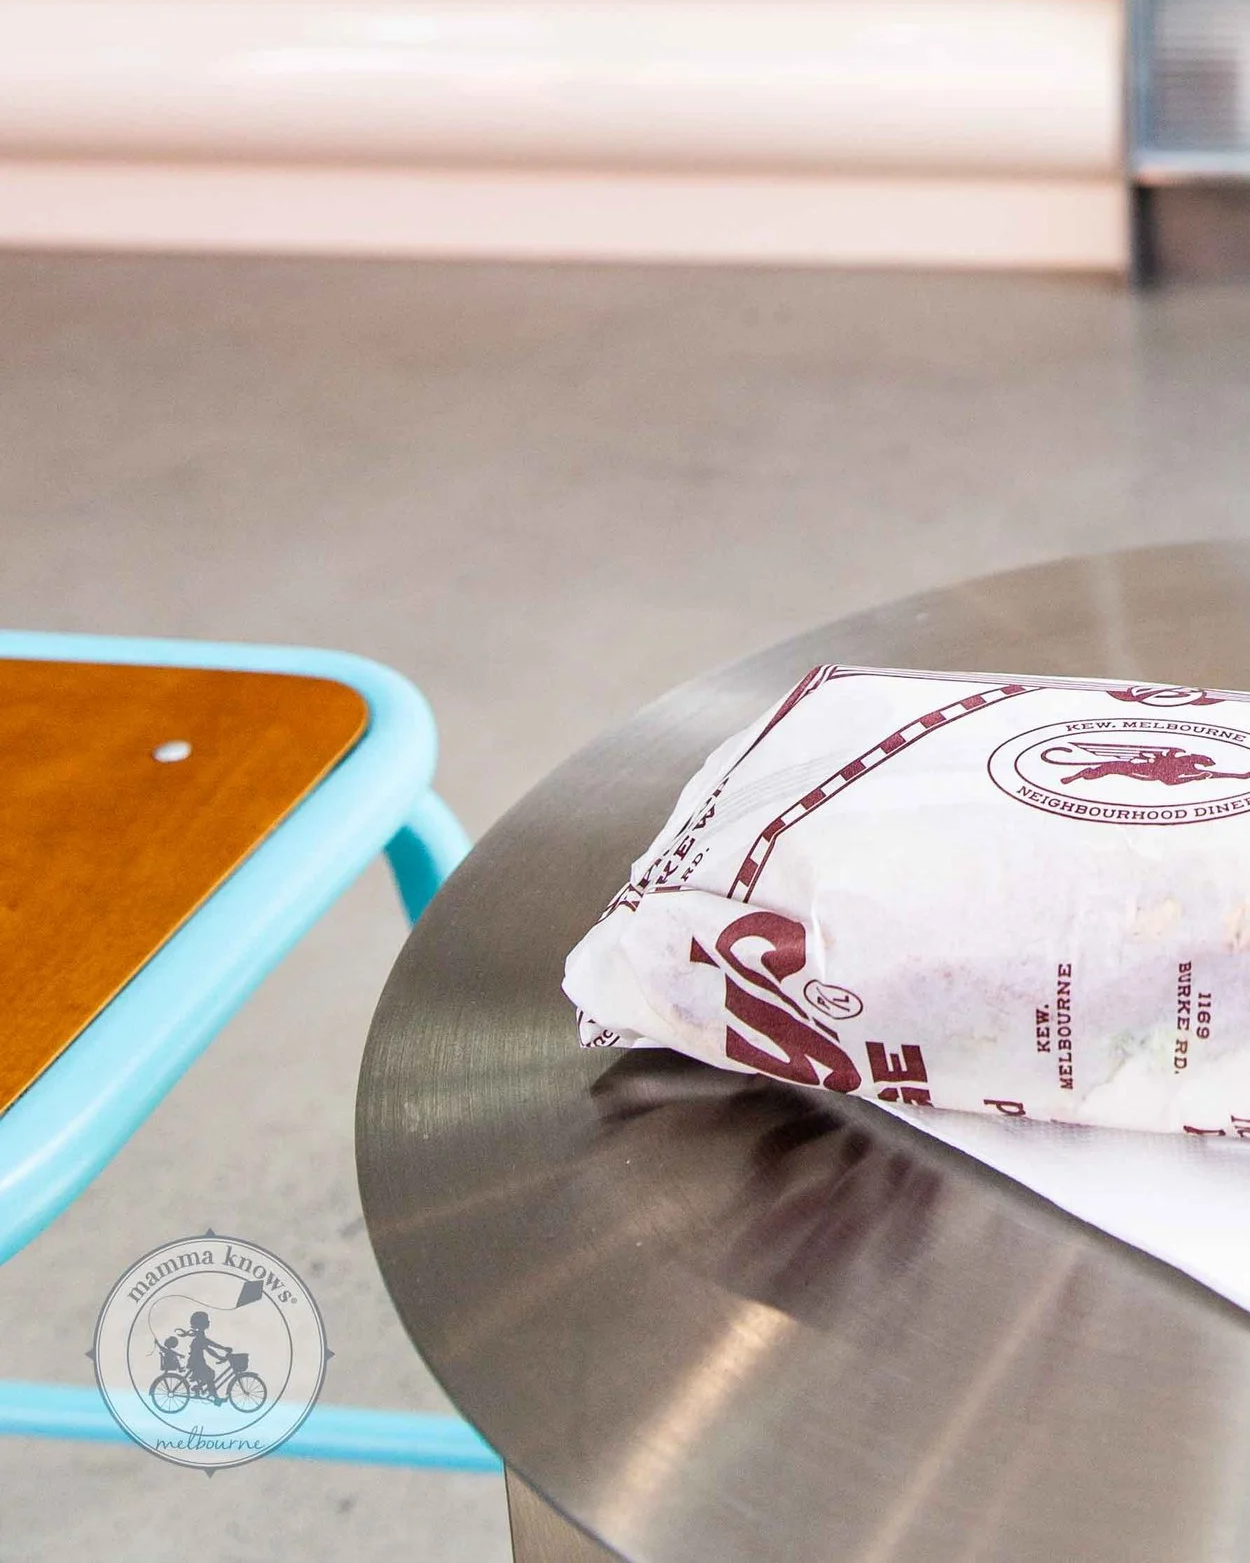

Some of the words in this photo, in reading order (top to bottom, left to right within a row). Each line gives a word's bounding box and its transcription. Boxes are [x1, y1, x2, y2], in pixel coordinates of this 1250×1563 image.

[1066, 721, 1116, 733] KEW.
[1122, 720, 1247, 743] MELBOURNE
[1016, 785, 1188, 821] NEIGHBOURHOOD
[1176, 960, 1192, 1031] BURKE
[1196, 992, 1212, 1039] 1169
[1036, 1002, 1051, 1053] KEW.
[1056, 963, 1073, 1090] MELBOURNE
[1173, 1038, 1189, 1075] RD.
